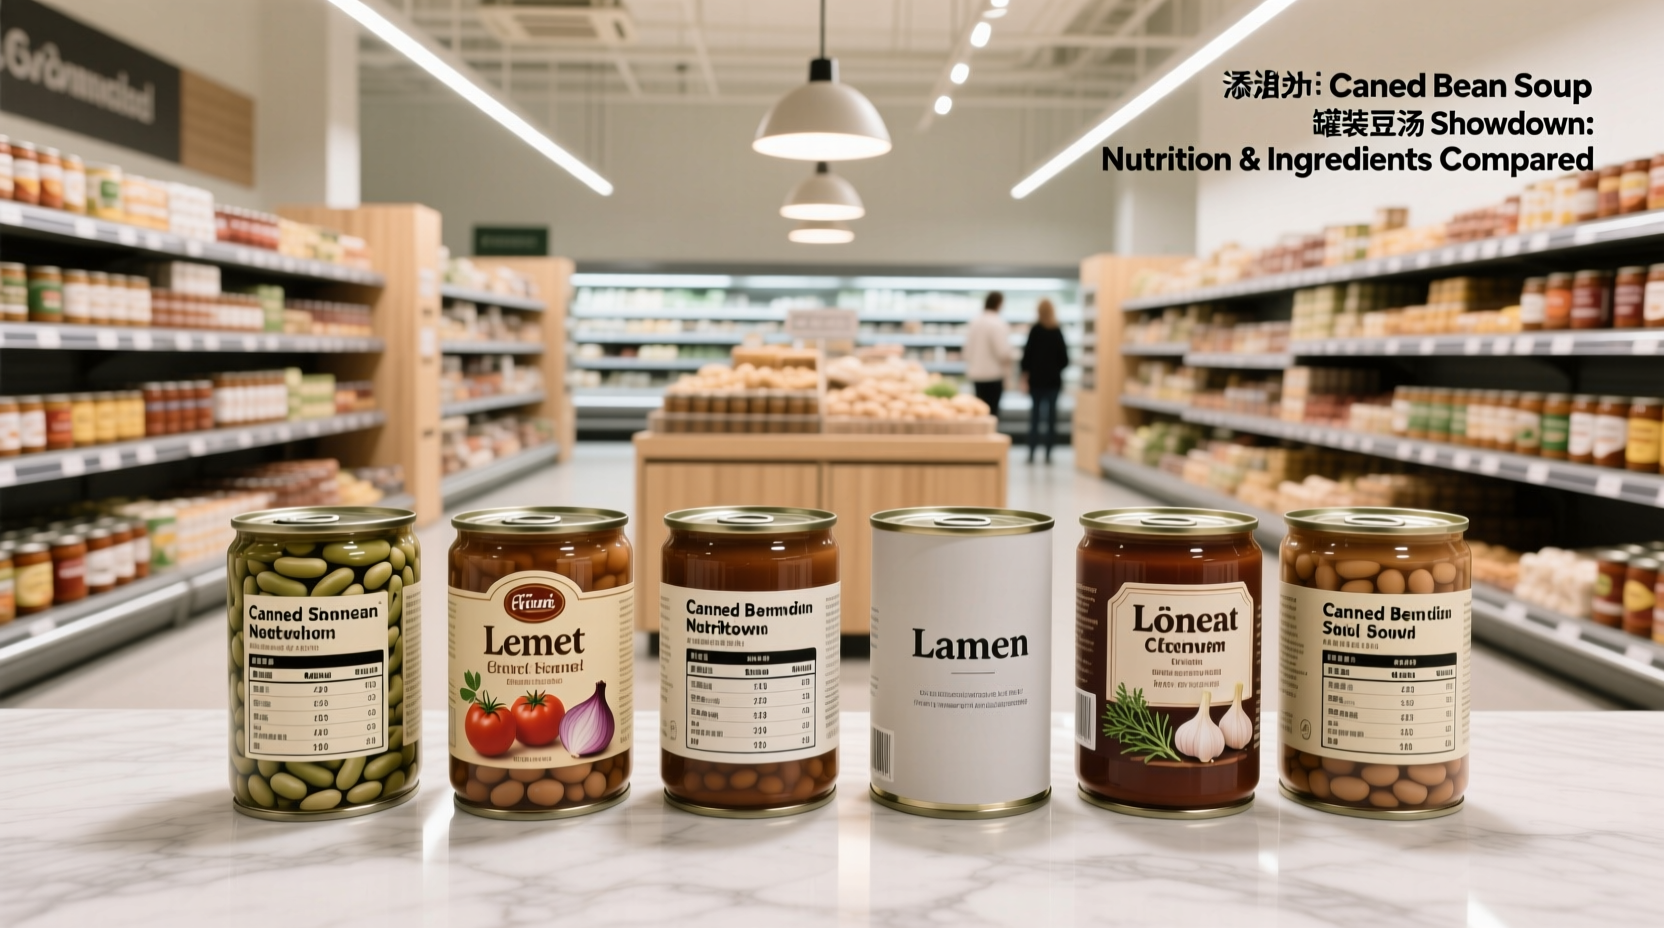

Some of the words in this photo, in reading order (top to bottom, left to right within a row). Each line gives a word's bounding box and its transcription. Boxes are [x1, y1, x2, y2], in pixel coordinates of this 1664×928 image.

[248, 604, 303, 622] Canned
[687, 598, 740, 617] Canned
[1133, 604, 1239, 634] Löneat
[1322, 602, 1385, 621] Canned
[483, 625, 585, 656] Lemet
[912, 627, 1029, 660] Lamen
